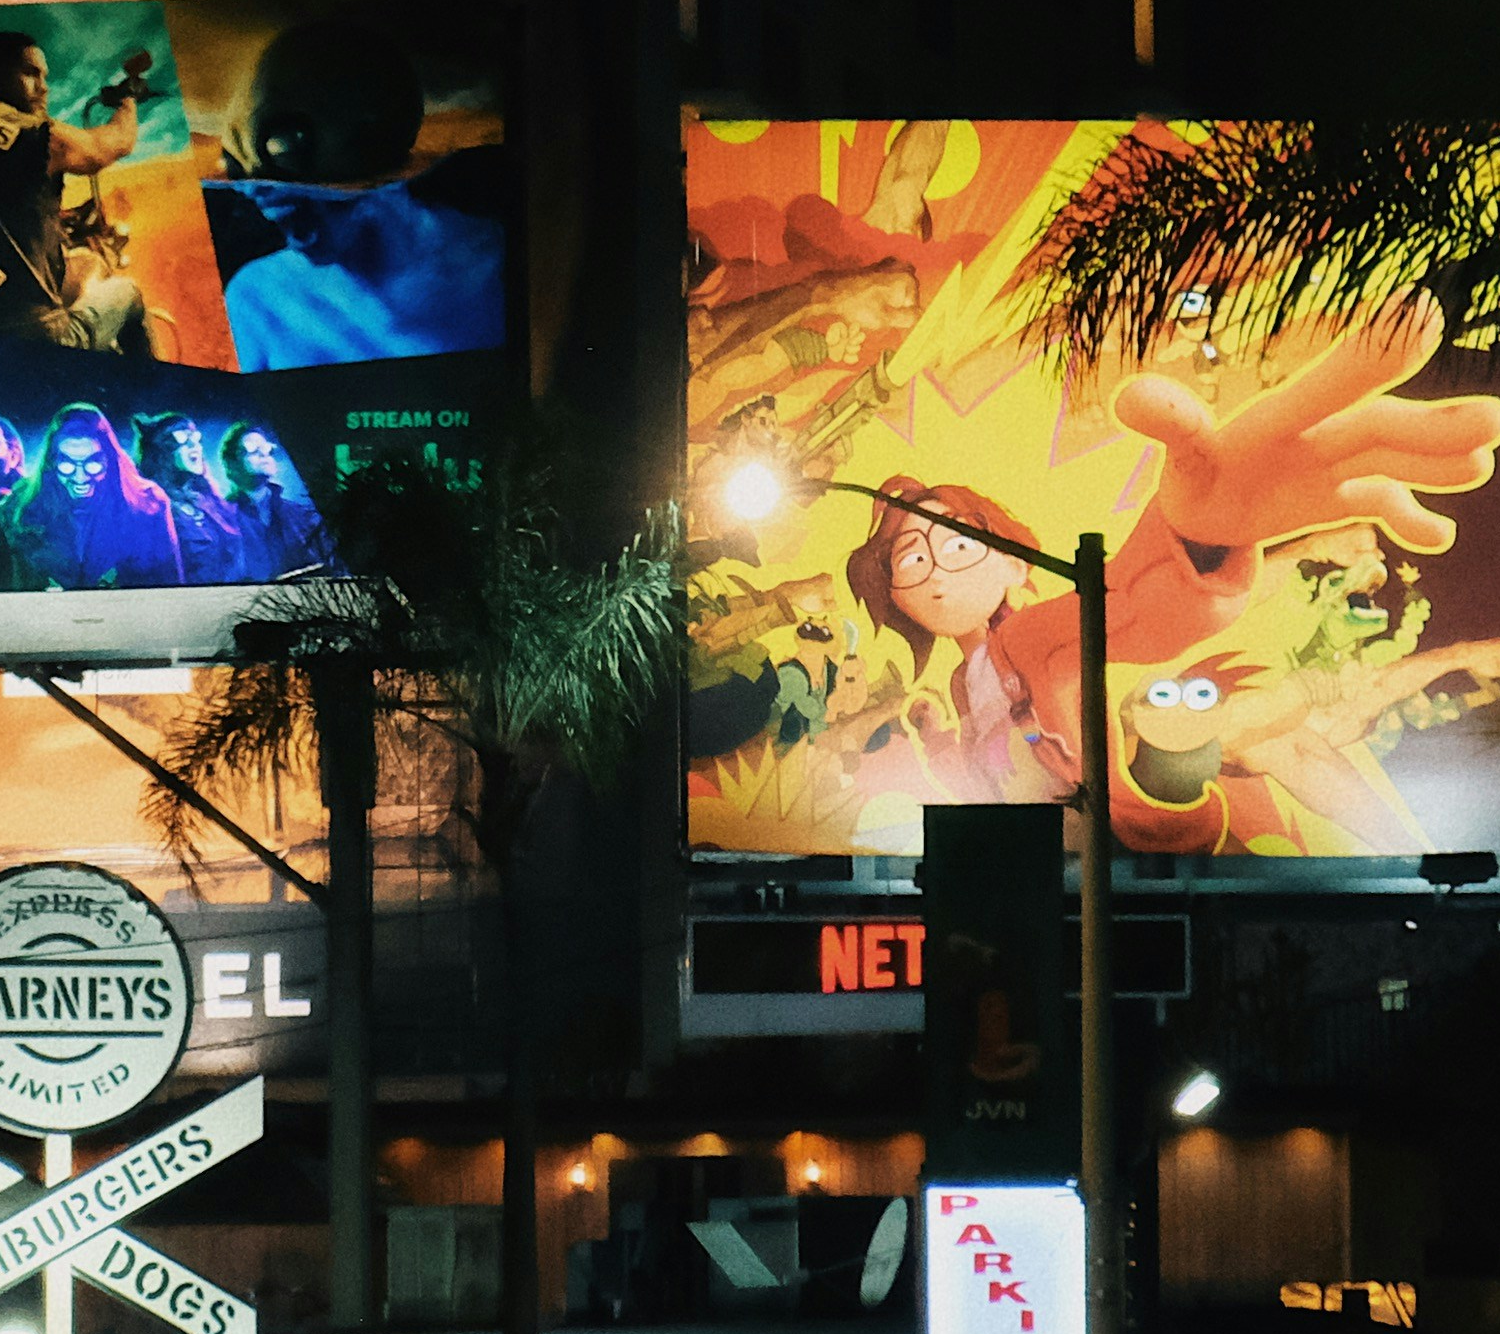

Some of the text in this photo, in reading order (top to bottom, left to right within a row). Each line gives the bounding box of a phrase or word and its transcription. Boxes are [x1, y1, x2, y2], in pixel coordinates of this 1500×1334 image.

[346, 410, 469, 429] STREAM ON
[202, 952, 312, 1020] EL
[819, 923, 926, 995] NET
